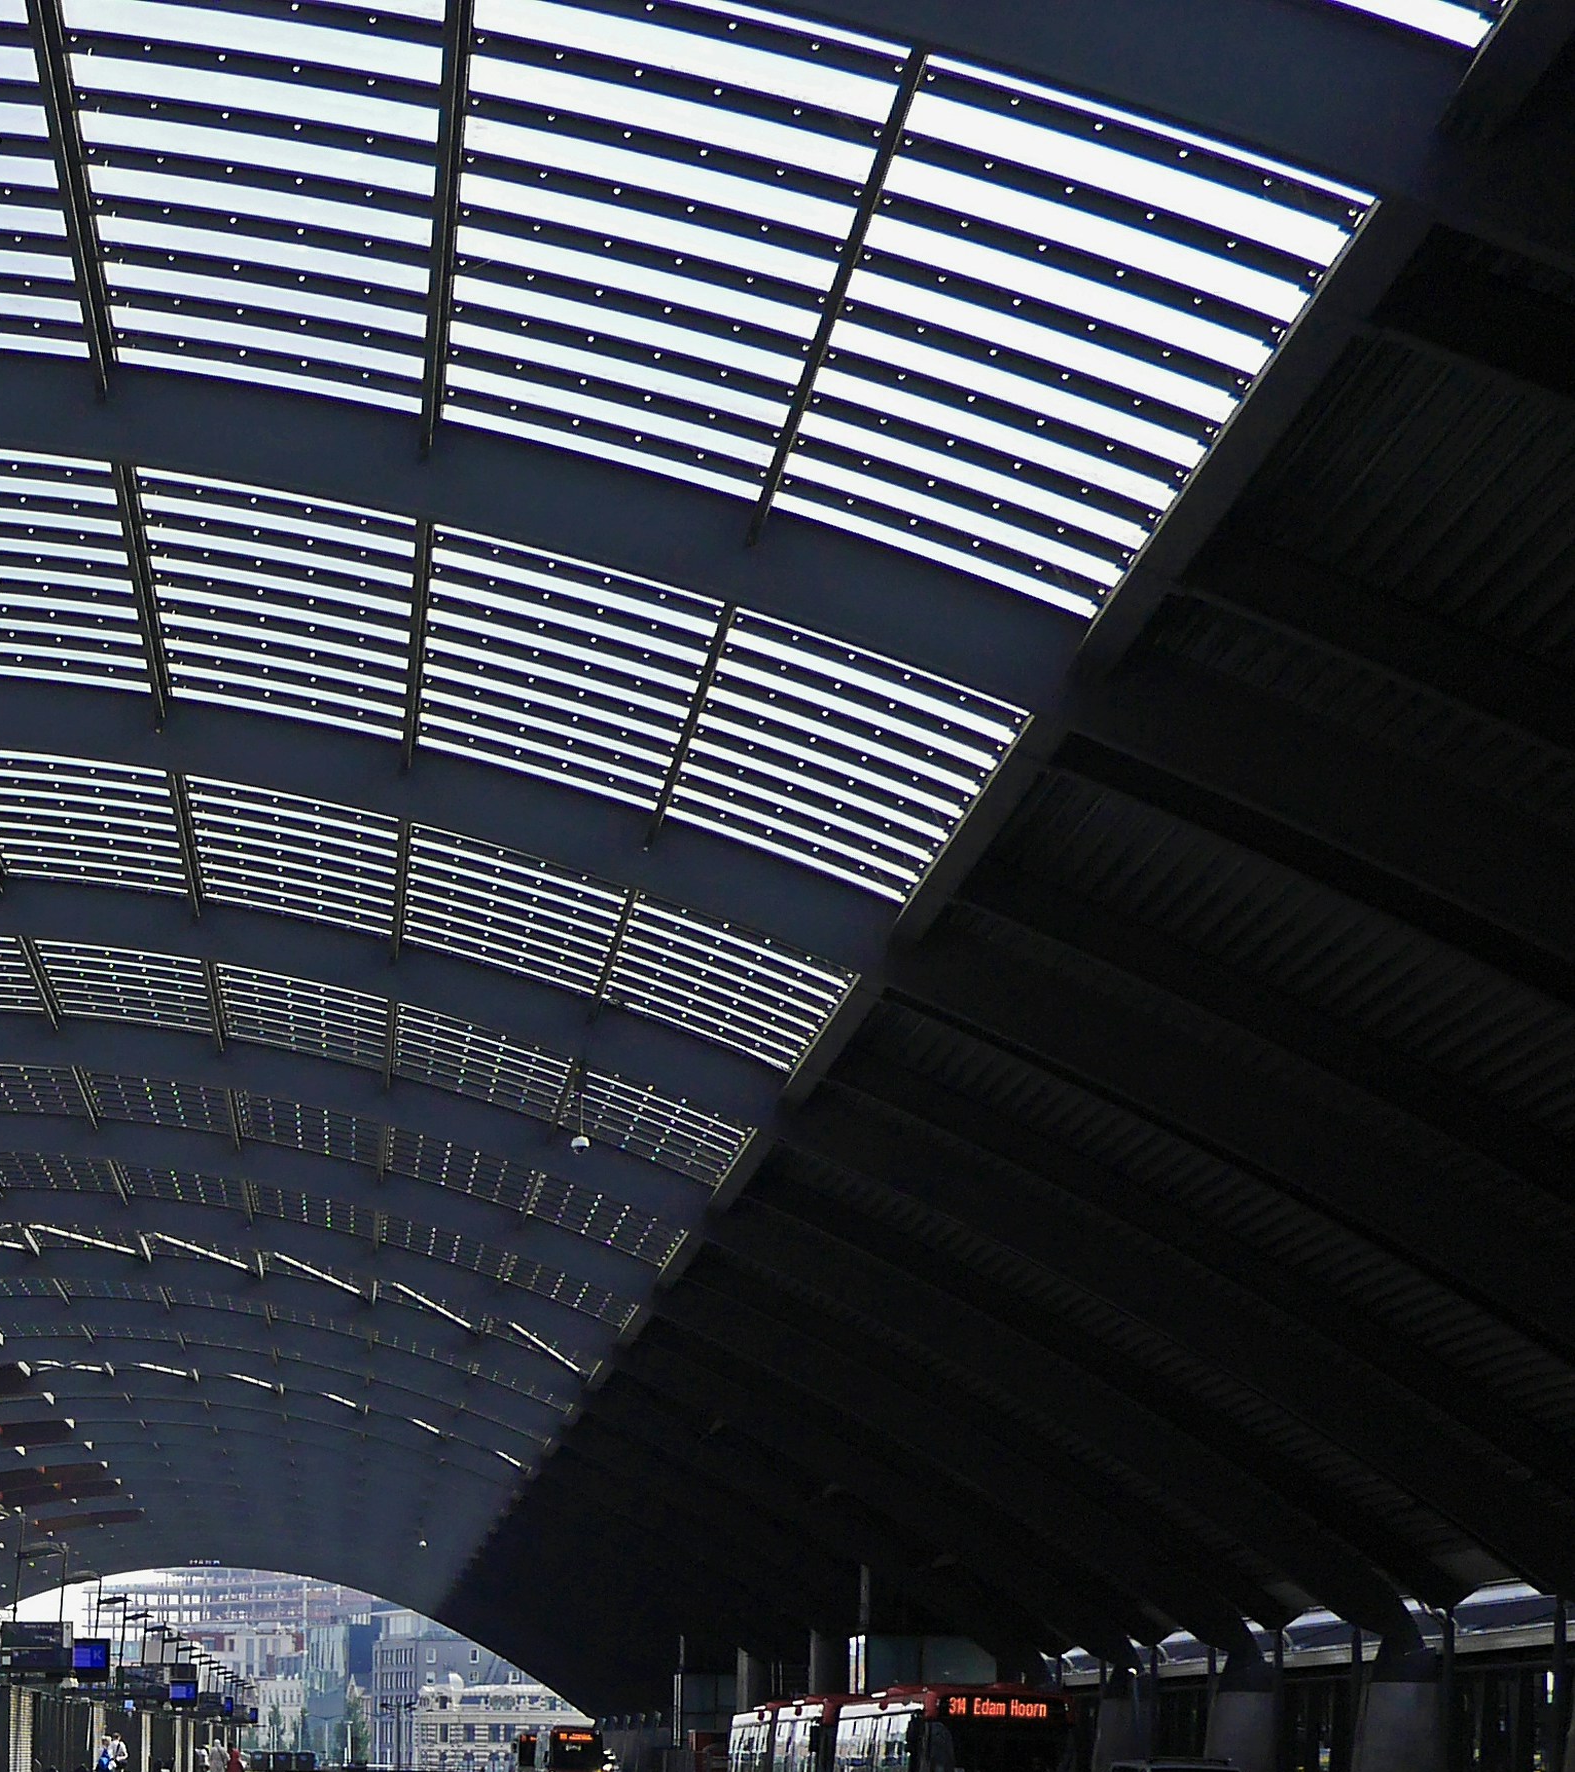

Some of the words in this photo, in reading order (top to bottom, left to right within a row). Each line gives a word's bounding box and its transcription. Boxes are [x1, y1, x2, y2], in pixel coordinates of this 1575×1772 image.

[949, 1697, 966, 1714] 314
[973, 1697, 1005, 1715] Edam
[1010, 1699, 1047, 1717] Hoorn
